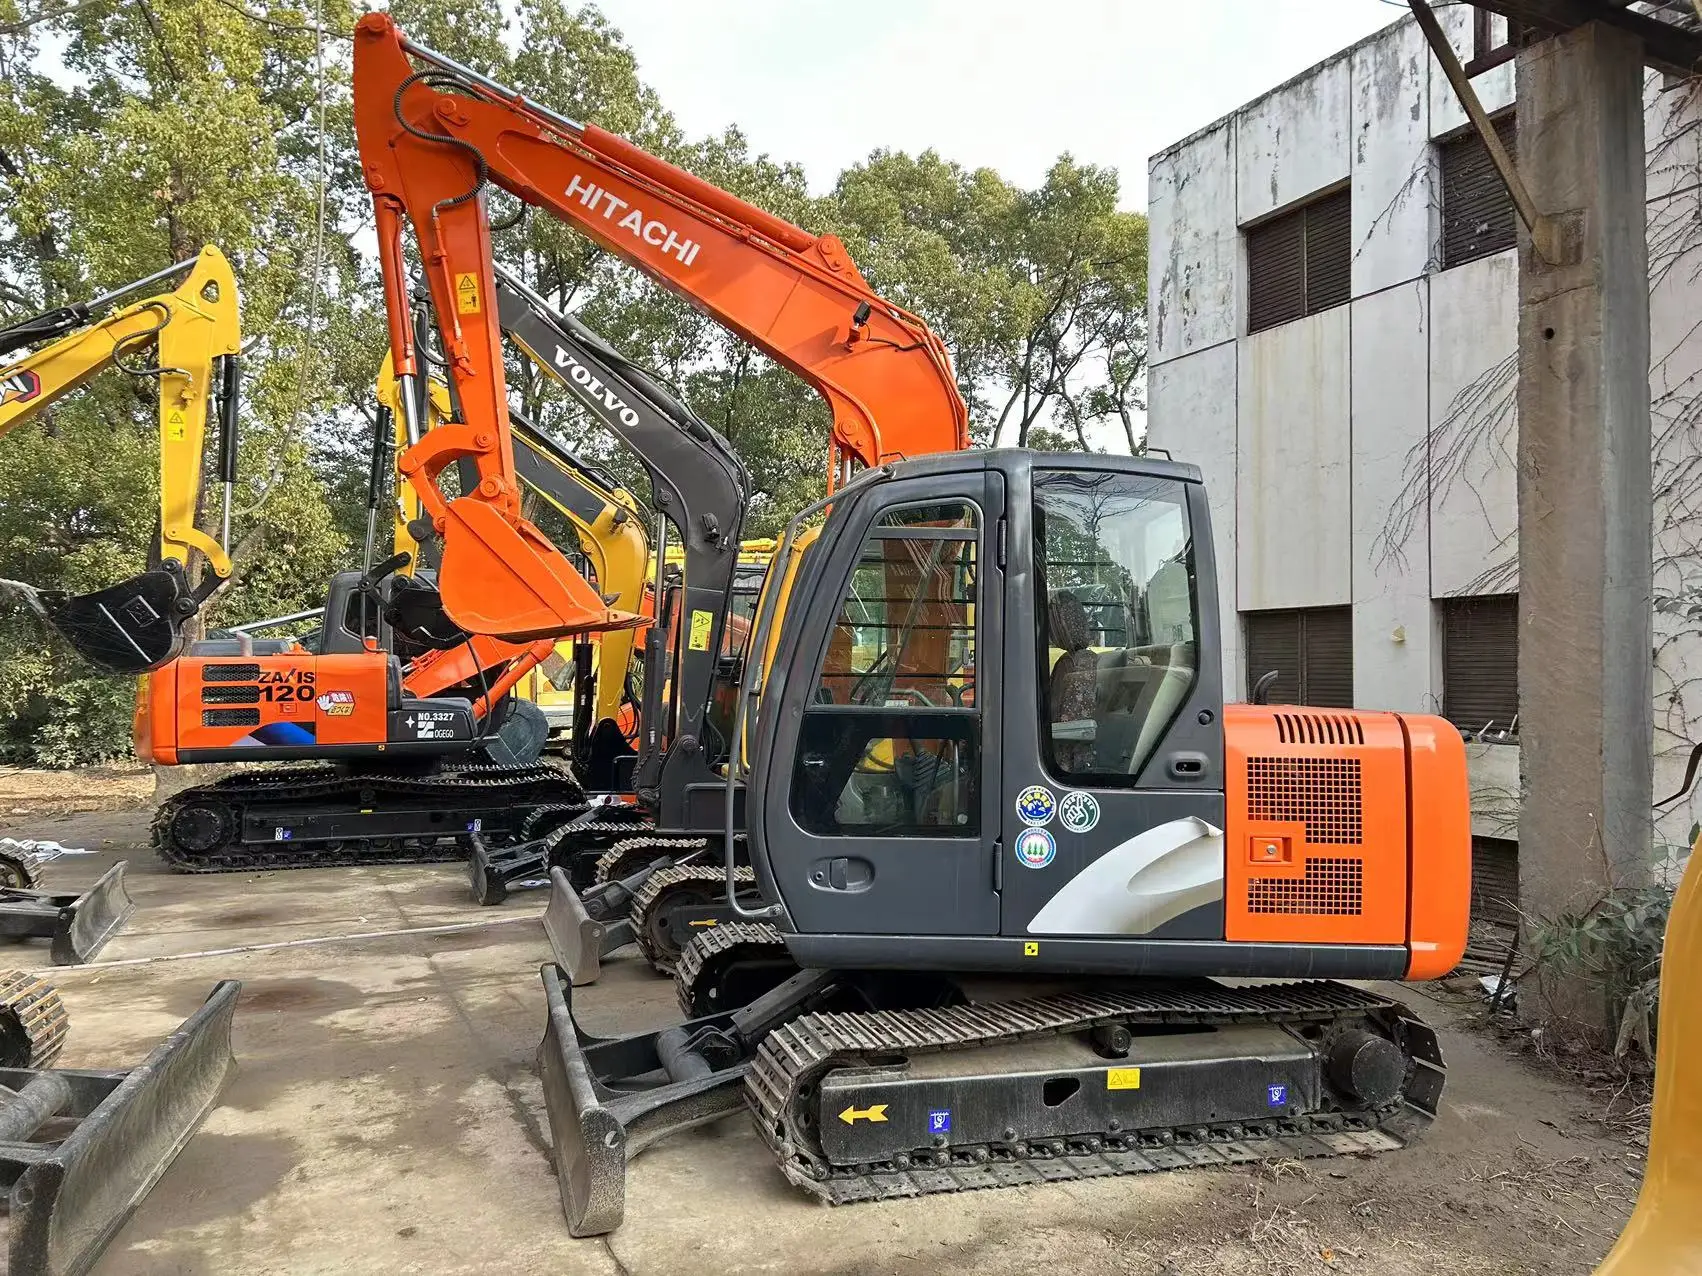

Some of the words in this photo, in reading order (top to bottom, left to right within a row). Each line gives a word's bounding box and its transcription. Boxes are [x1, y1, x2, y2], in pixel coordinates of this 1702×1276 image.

[564, 174, 702, 267] HITACHI
[554, 344, 640, 427] VOLVO
[258, 685, 315, 702] 120
[417, 712, 455, 721] NO.3327
